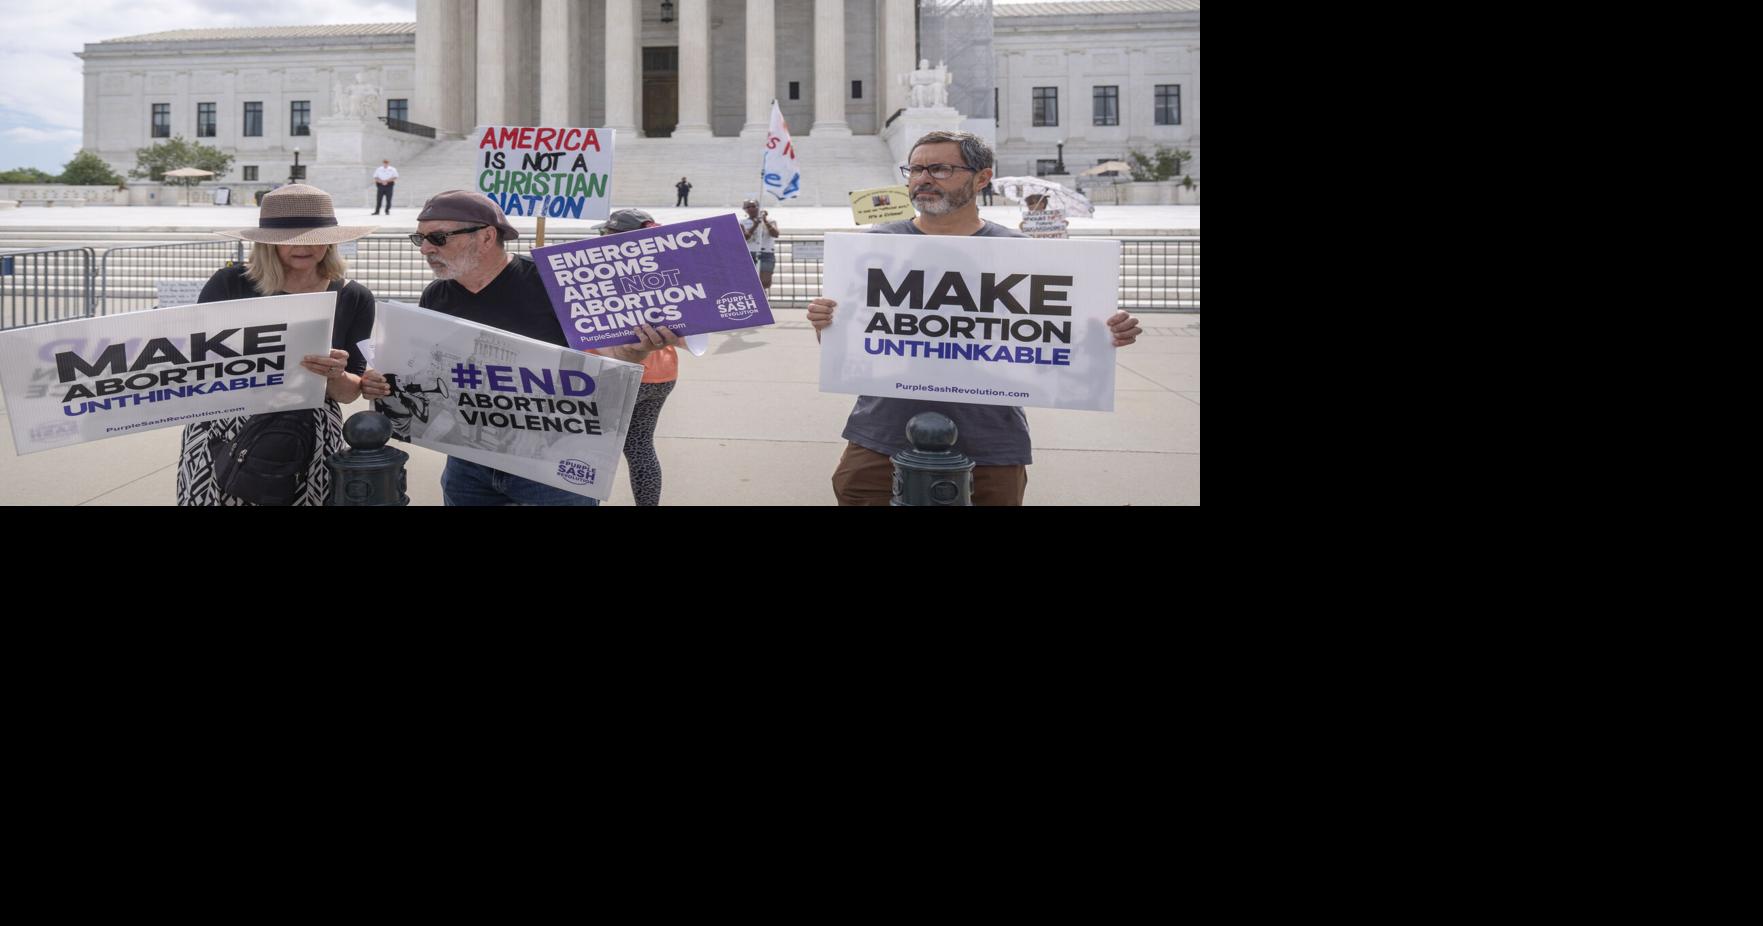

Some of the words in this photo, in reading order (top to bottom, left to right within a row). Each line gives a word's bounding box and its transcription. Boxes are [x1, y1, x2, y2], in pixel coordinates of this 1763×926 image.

[480, 127, 600, 152] AMERICA
[485, 151, 505, 169] IS
[522, 152, 566, 172] NOT
[571, 153, 588, 172] A
[479, 169, 608, 198] CHRISTIAN
[488, 192, 585, 218] NATION
[547, 228, 712, 271] EMERGENCY
[555, 256, 659, 287] ROOMS
[563, 280, 618, 303] ARE
[620, 269, 680, 294] NOT
[570, 283, 706, 319] ABORTION
[717, 300, 757, 313] SASH
[867, 268, 1073, 316] MAKE
[575, 305, 682, 334] CLINICS
[864, 312, 1071, 344] ABORTION
[55, 323, 288, 383] MAKE
[864, 338, 1071, 366] UNTHINKABLE
[61, 355, 285, 402] ABORTION
[451, 363, 596, 397] #END
[895, 382, 1030, 398] PurpleSashRevolution.com
[63, 373, 284, 416] UNTHINKABLE
[458, 392, 599, 416] ABORTION
[106, 406, 245, 433] PurpleSashRevolution.com
[459, 409, 602, 435] VIOLENCE
[558, 464, 595, 480] SASH
